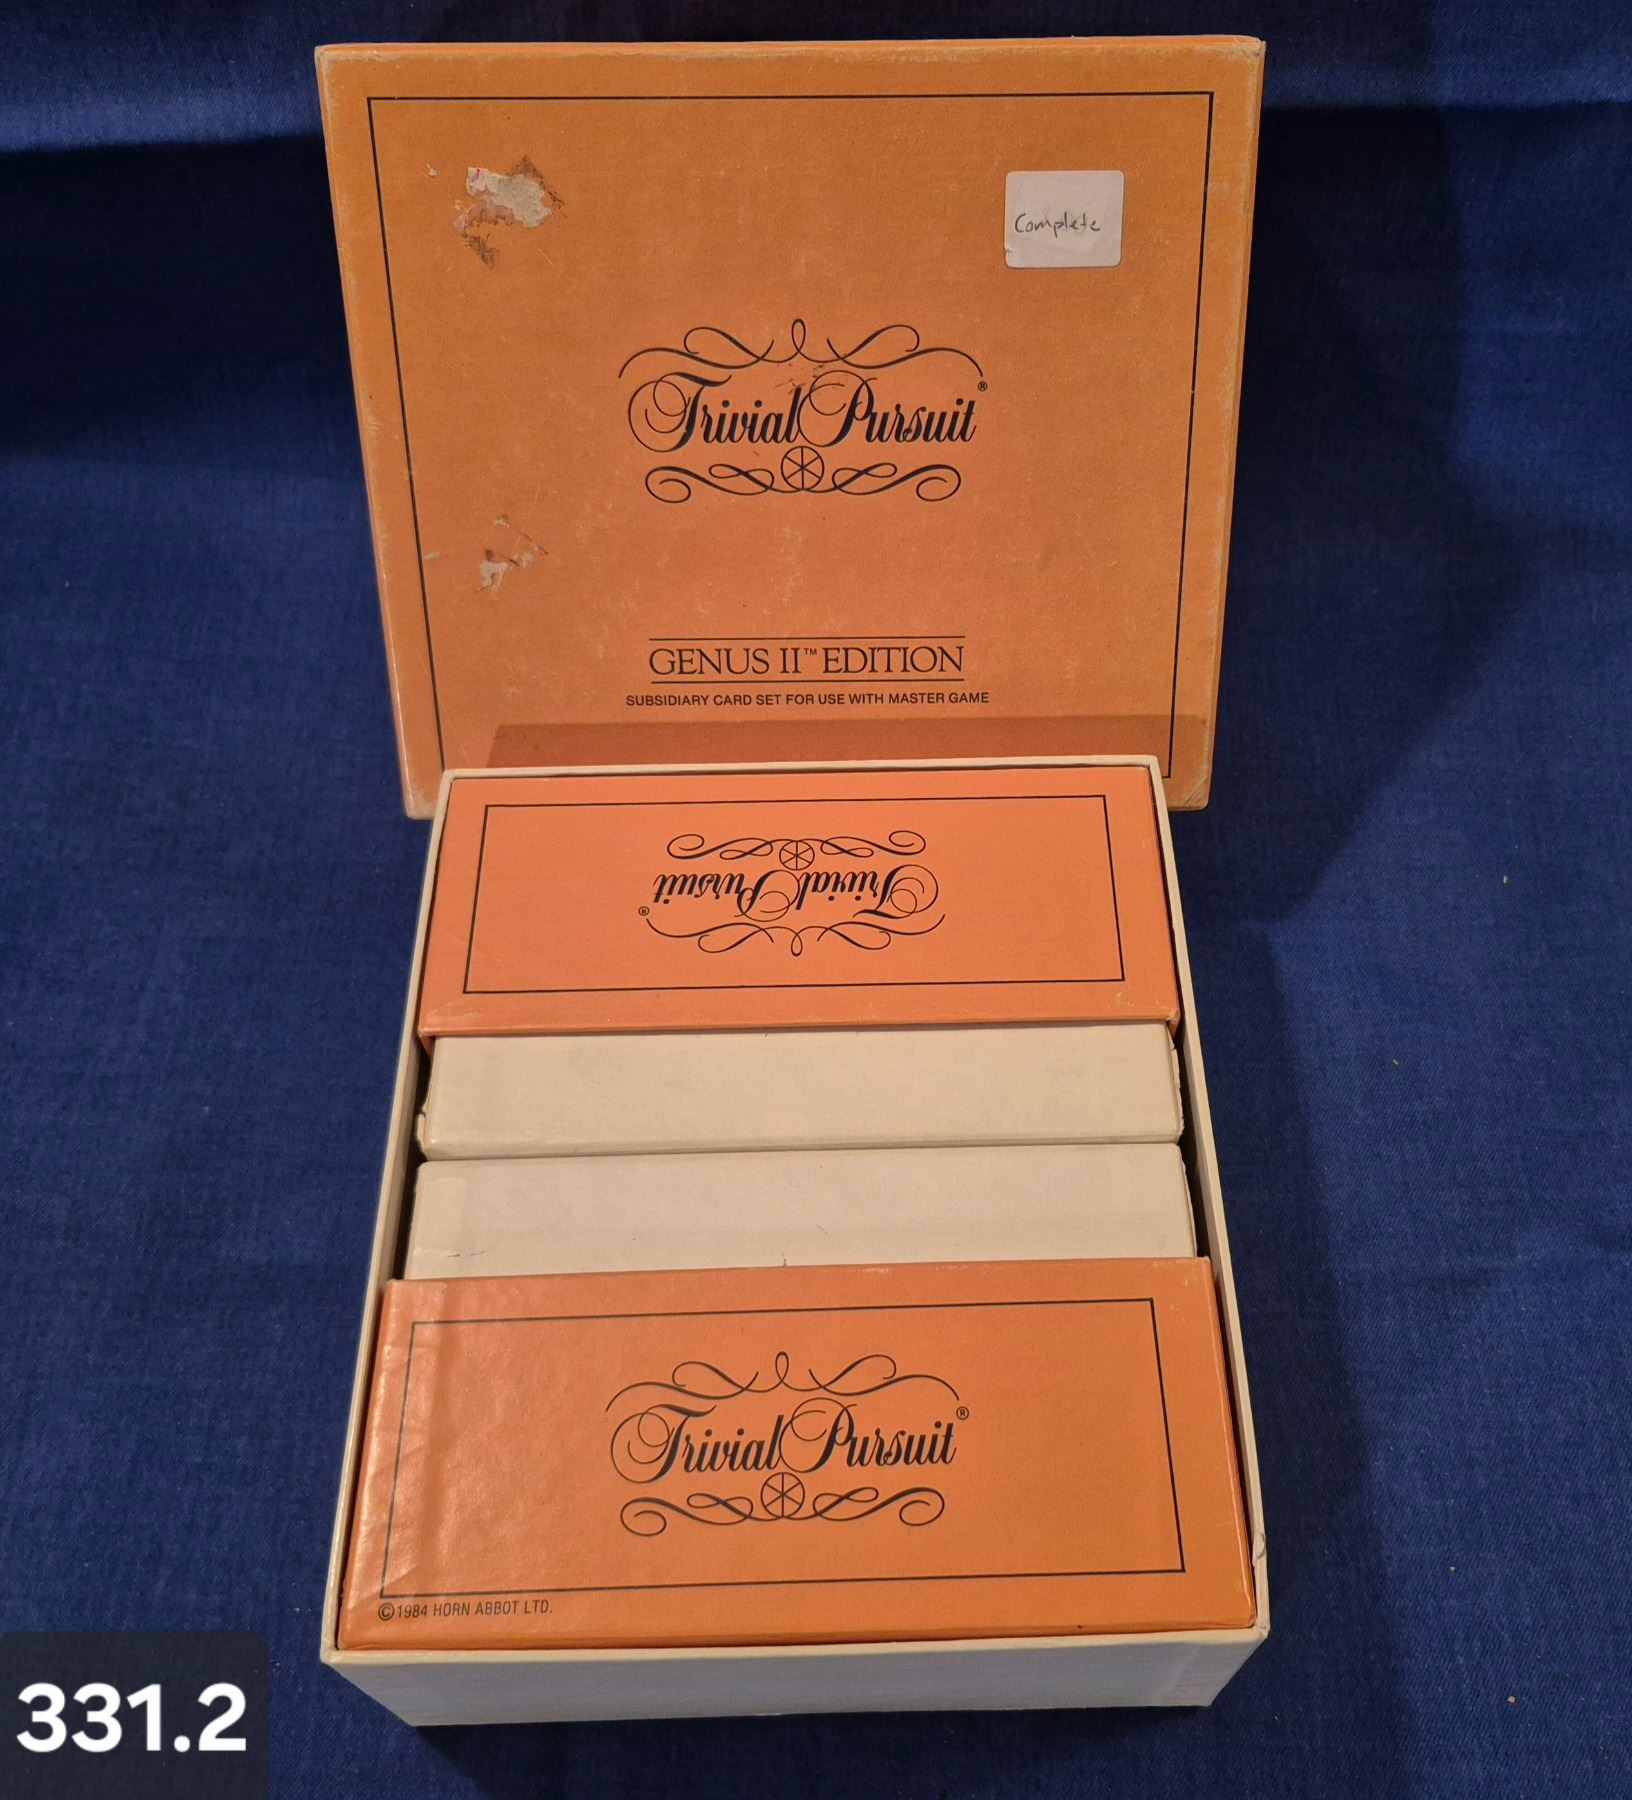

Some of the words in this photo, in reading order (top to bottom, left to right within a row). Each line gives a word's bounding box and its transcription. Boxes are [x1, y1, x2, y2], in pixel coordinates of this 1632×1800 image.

[1014, 211, 1101, 239] Complete
[628, 371, 803, 452] Trivial
[648, 647, 771, 676] GENUS
[822, 645, 965, 673] EDITION
[626, 694, 709, 706] SUBSIDIARY
[713, 694, 752, 706] CARD
[755, 694, 782, 705] SET
[786, 694, 814, 705] FOR
[818, 693, 845, 705] USE
[848, 693, 884, 705] WITH
[888, 692, 945, 704] MASTER
[948, 692, 990, 704] GAME
[795, 864, 939, 919] Trivial
[611, 1404, 785, 1484] Trivial
[433, 1602, 471, 1617] HORN
[475, 1600, 520, 1616] ABBOT
[524, 1599, 553, 1614] LTD.
